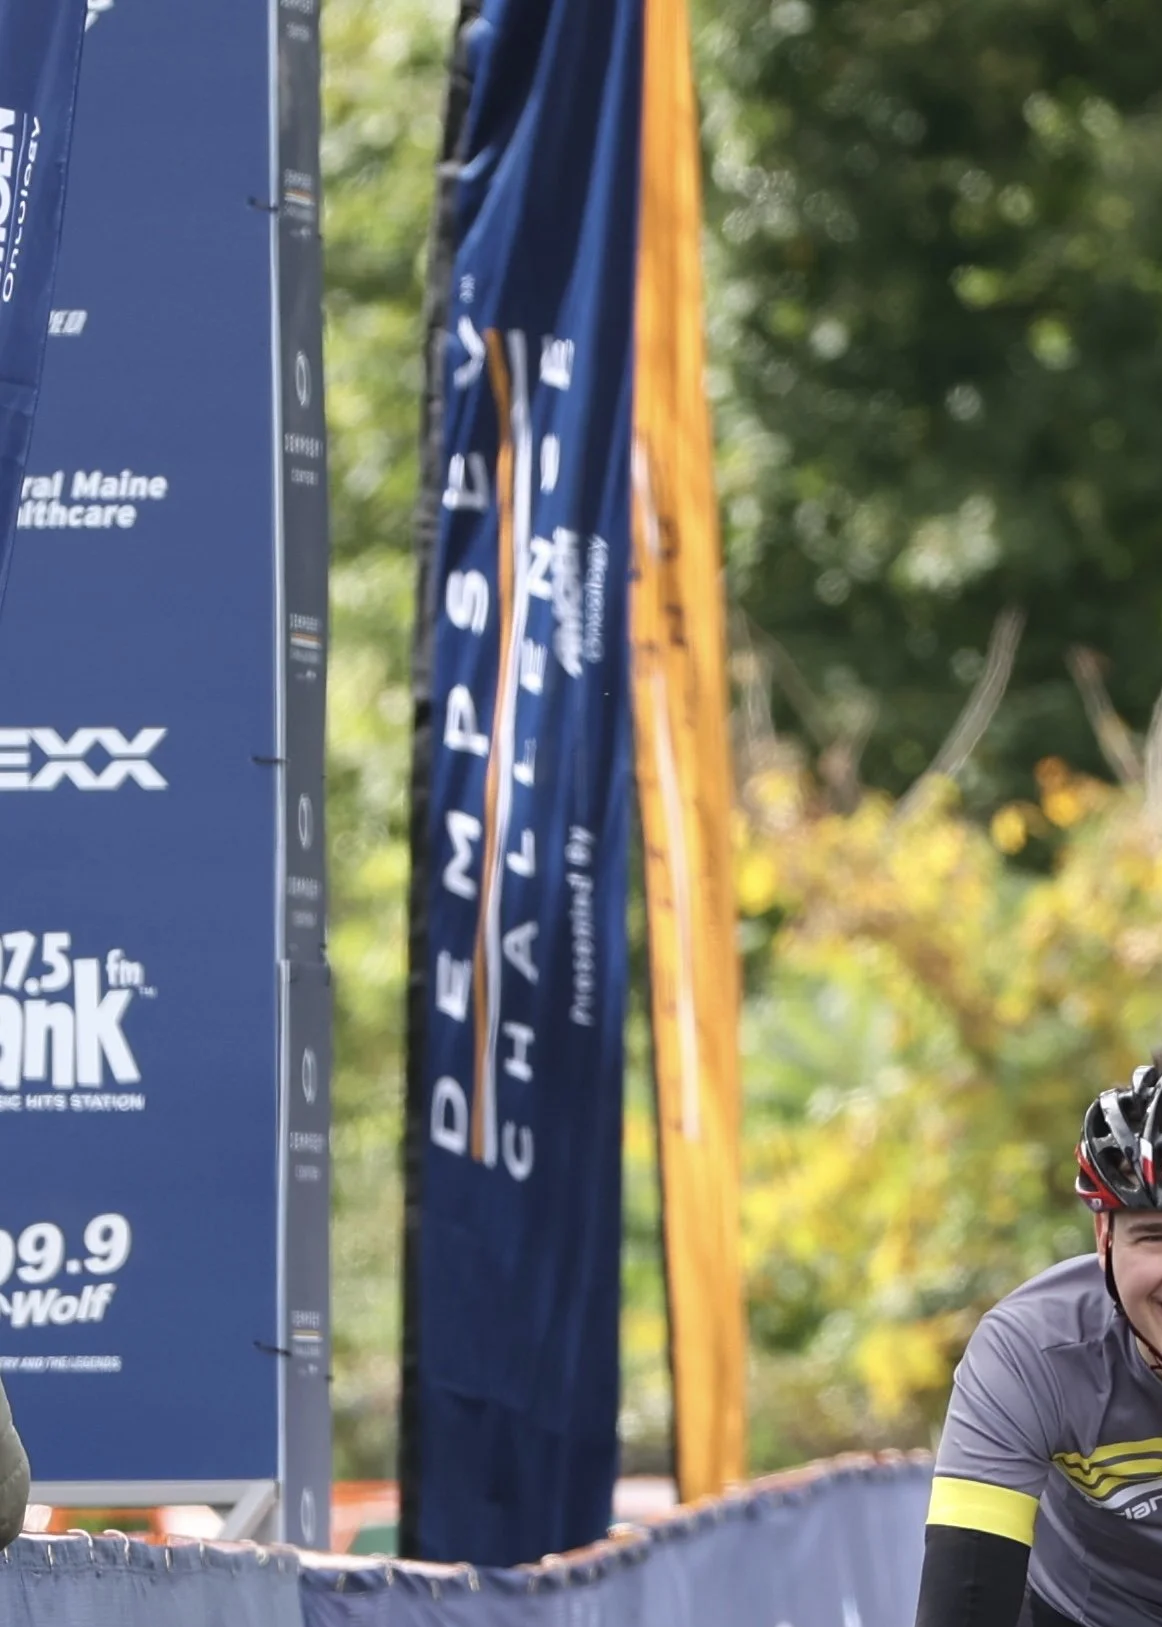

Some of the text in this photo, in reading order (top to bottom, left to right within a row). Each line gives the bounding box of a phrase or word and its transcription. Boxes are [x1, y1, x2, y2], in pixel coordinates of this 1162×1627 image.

[71, 469, 168, 499] Maine
[0, 930, 71, 993] 7.5
[70, 1093, 145, 1112] STATION
[10, 1283, 117, 1329] Wolf
